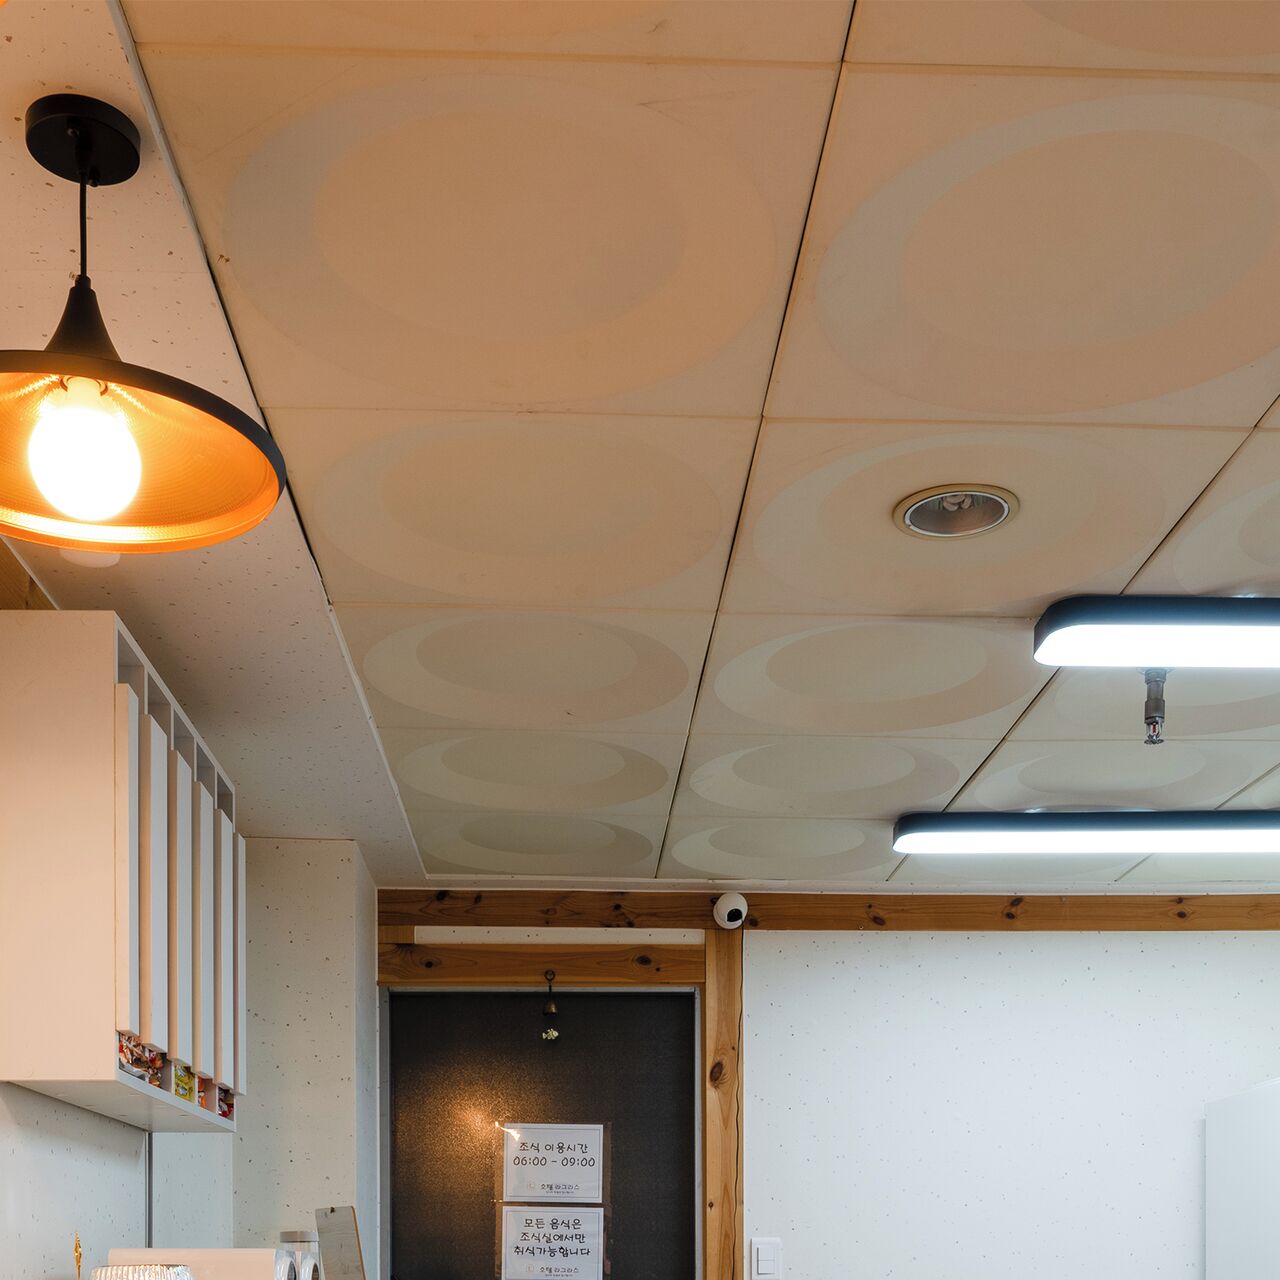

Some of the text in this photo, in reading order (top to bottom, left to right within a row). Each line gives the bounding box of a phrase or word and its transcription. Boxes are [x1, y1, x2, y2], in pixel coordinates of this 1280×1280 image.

[520, 1142, 588, 1154] 조식 이용시간
[513, 1156, 547, 1166] 06:00
[561, 1157, 596, 1167] 09:00
[524, 1218, 581, 1230] 모든 음식은
[520, 1232, 585, 1243] 조식실에서만
[514, 1245, 591, 1258] 취식가능합니다
